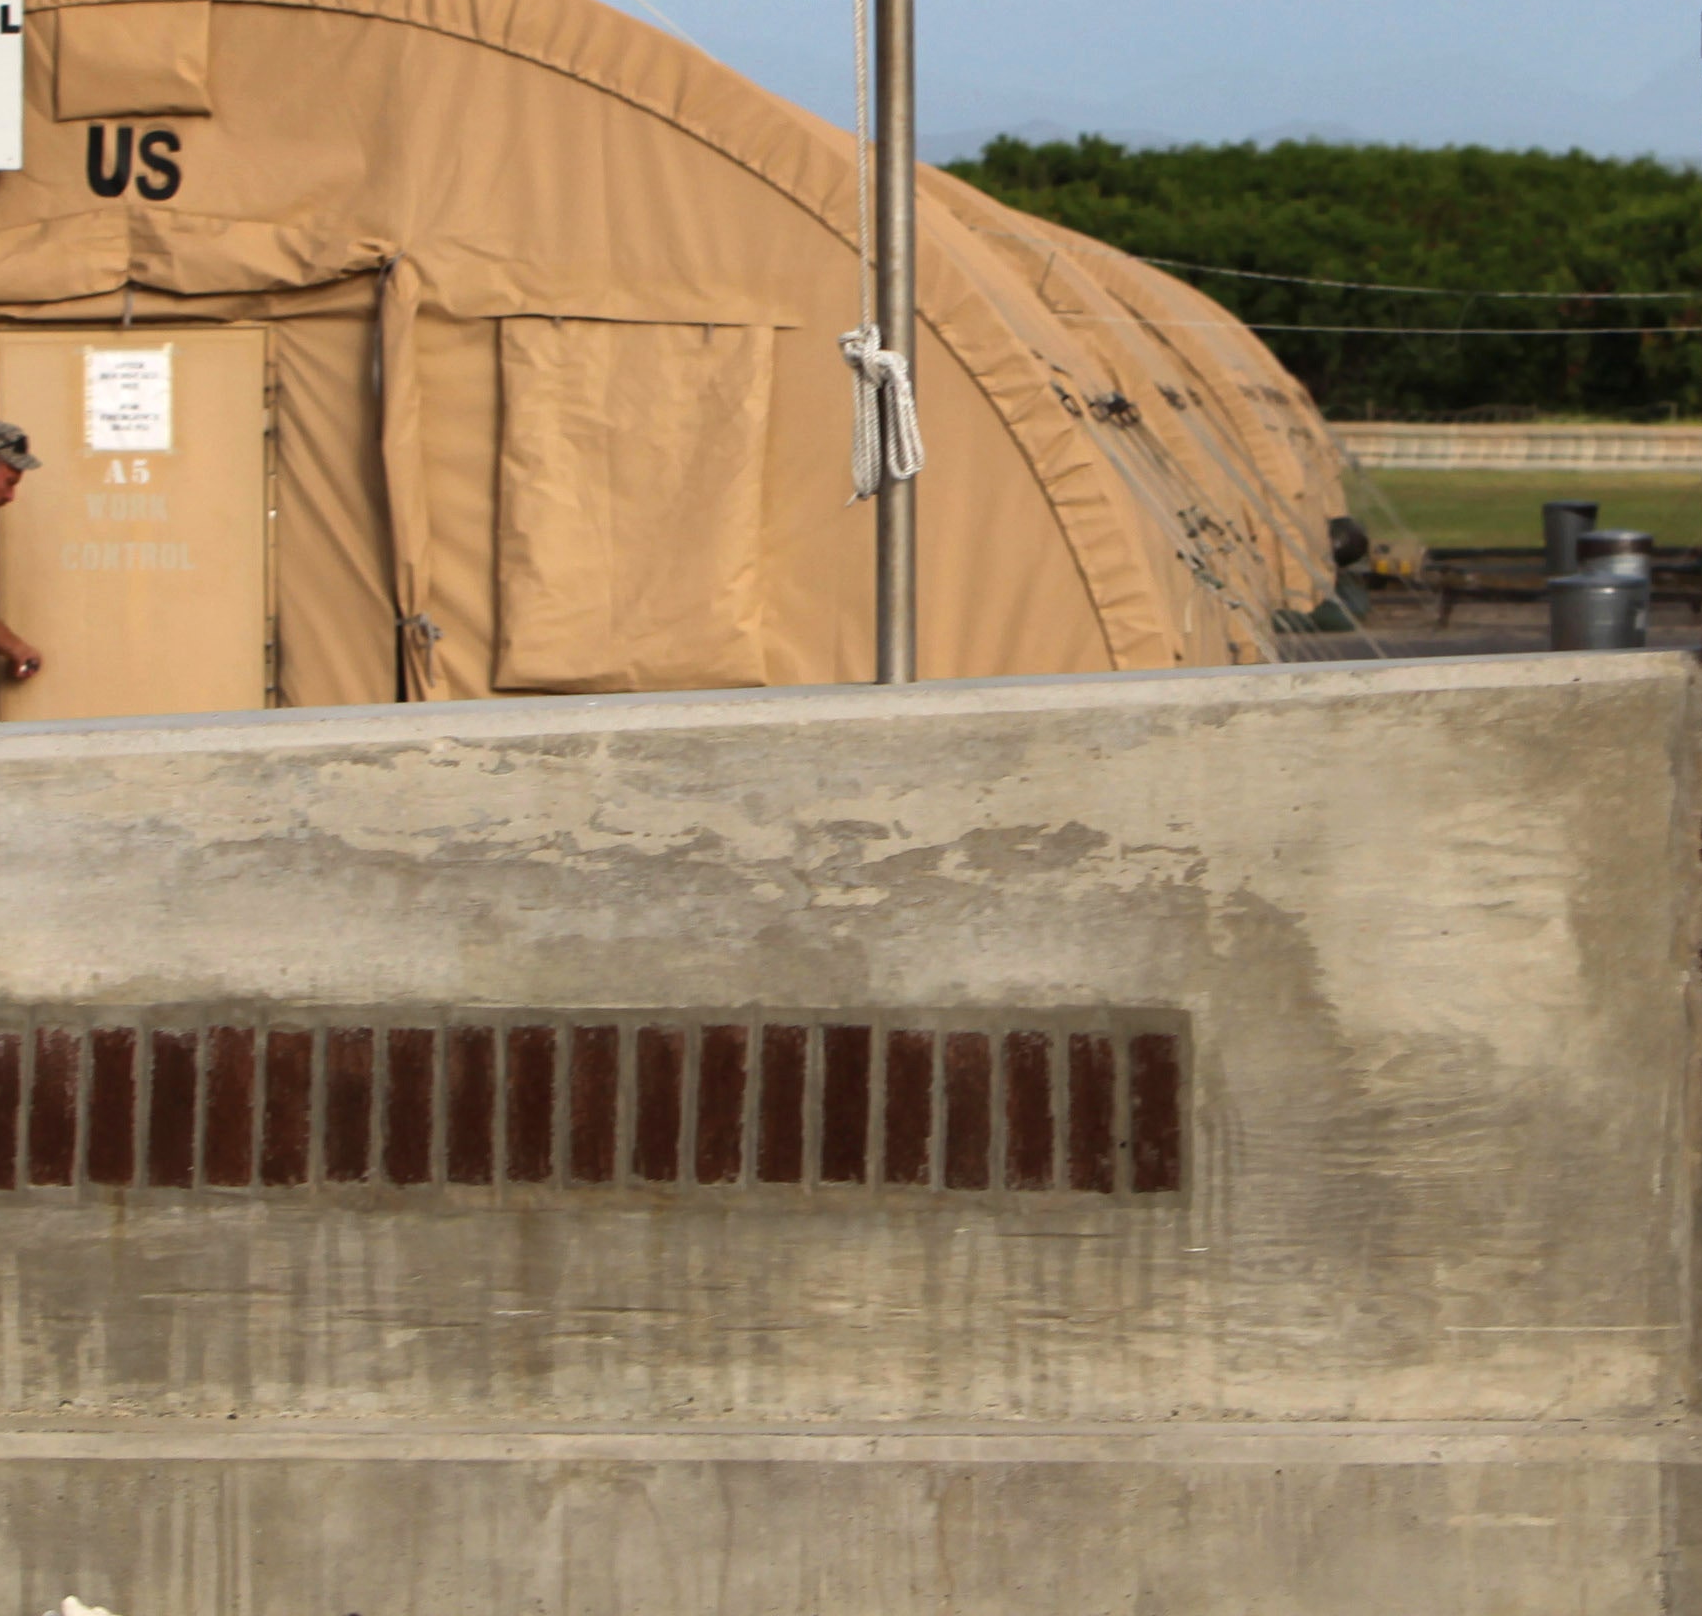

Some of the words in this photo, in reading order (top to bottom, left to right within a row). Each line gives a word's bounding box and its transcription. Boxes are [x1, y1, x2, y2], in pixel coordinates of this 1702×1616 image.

[87, 126, 180, 200] US
[105, 458, 150, 484] A5
[85, 493, 167, 521] WORK
[60, 542, 196, 571] CONTROL
